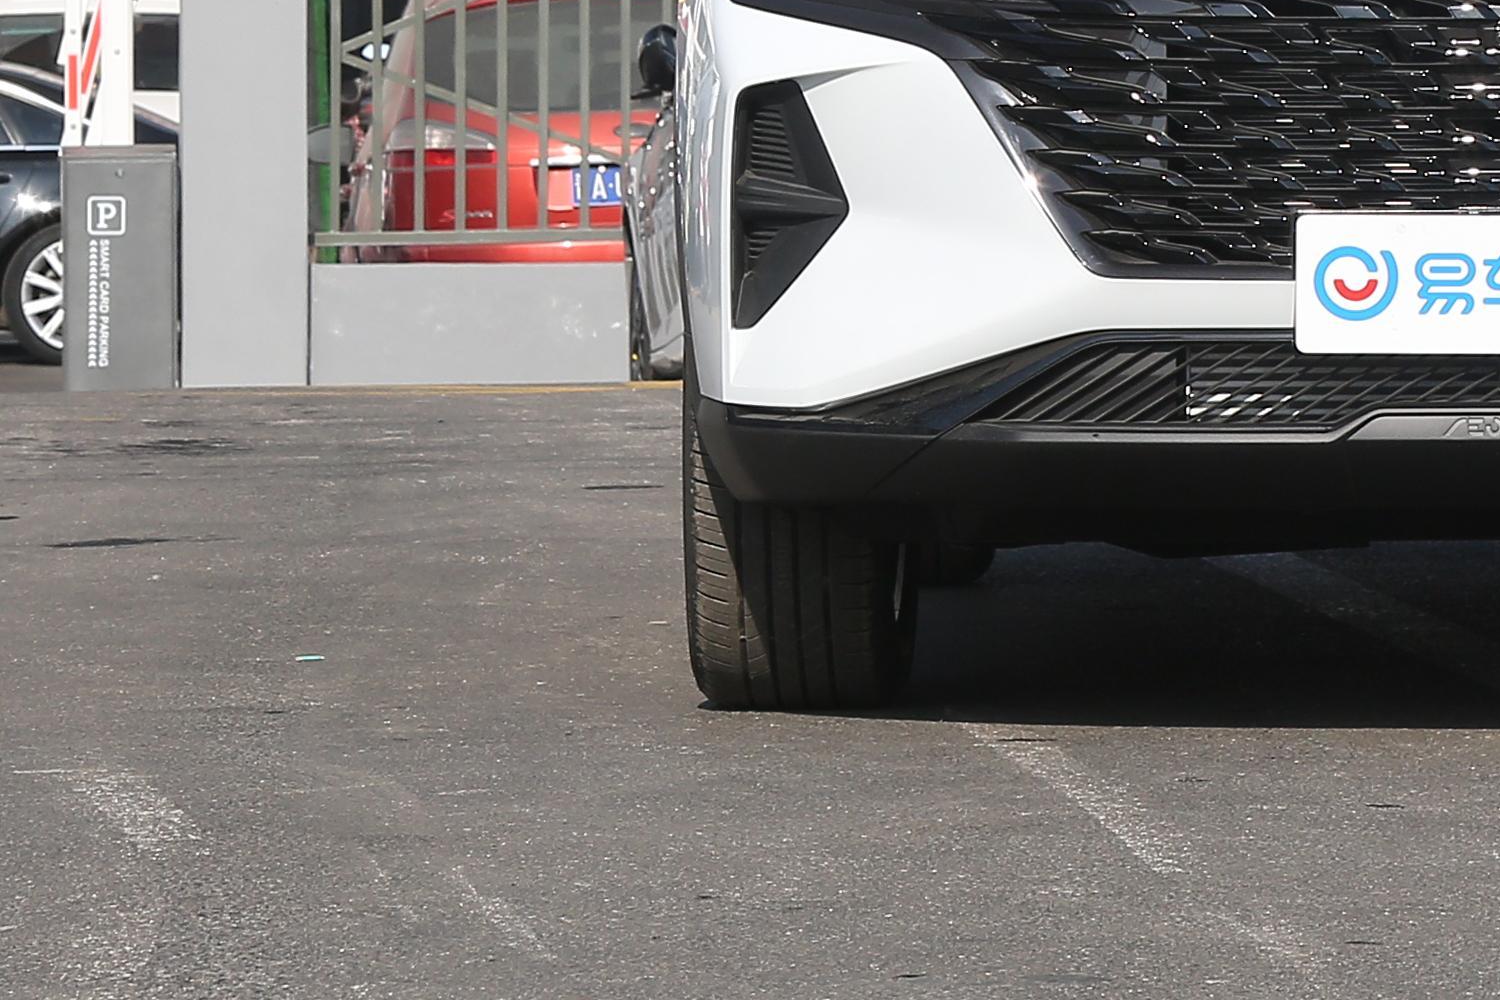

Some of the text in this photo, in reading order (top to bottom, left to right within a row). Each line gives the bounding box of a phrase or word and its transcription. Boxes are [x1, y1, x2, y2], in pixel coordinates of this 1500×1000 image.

[98, 239, 111, 368] SMART CARD PARKING
